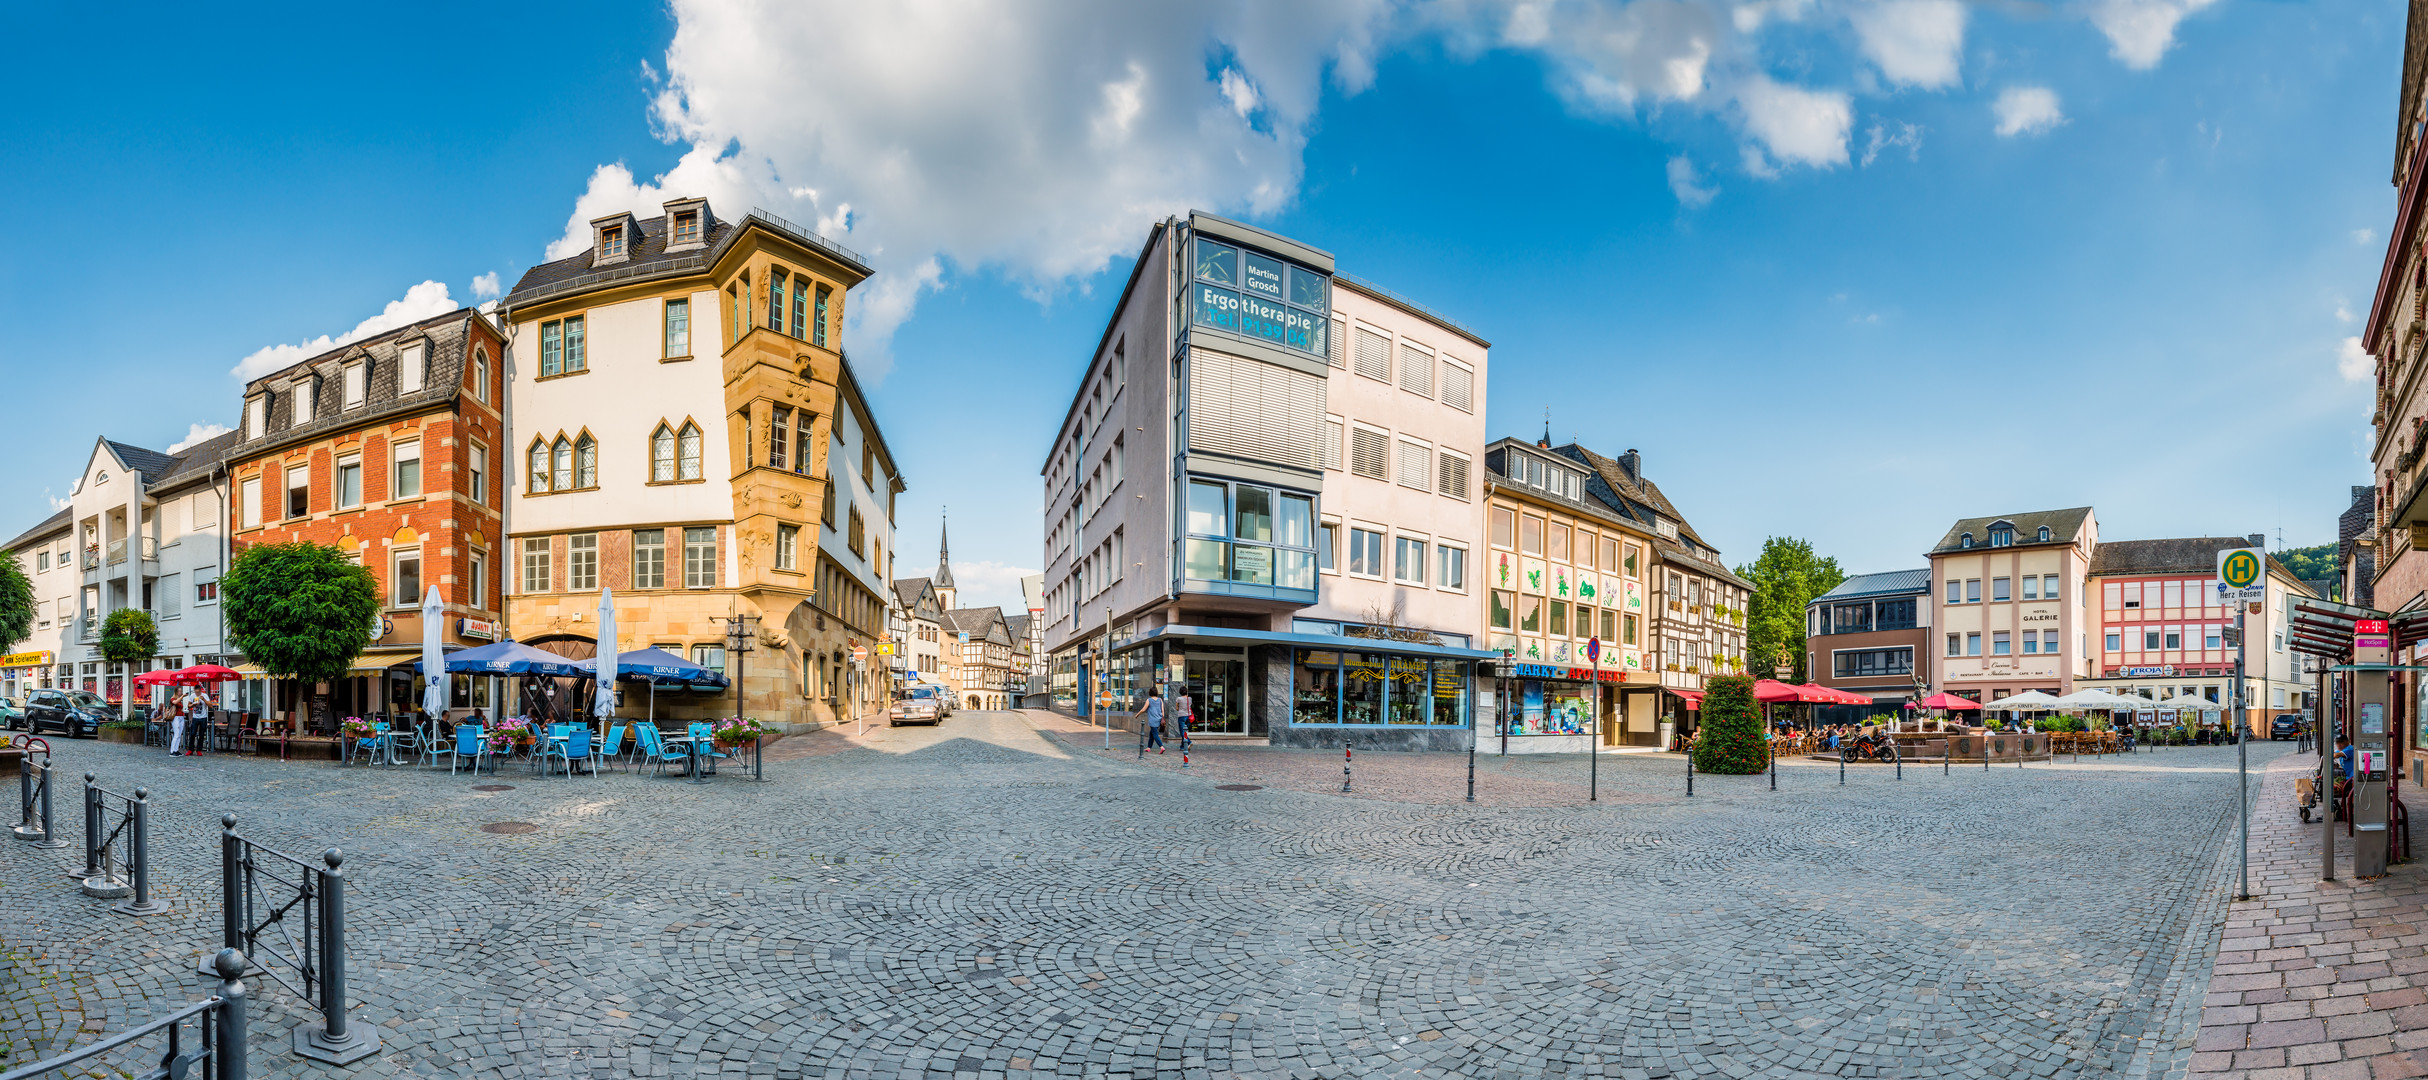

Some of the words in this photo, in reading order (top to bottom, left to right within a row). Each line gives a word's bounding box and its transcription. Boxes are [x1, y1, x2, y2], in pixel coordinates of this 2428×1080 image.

[1248, 265, 1279, 282] Martina
[1248, 277, 1279, 294] Grosch
[1208, 308, 1238, 328] Tel.
[2232, 559, 2249, 580] H
[2220, 591, 2235, 599] Herz
[2239, 590, 2261, 598] Reisen
[470, 621, 490, 633] AVANTI
[15, 653, 40, 665] Spielwaren
[486, 661, 511, 669] KIRNER
[1344, 658, 1384, 668] Blumenhaus
[653, 666, 680, 674] KIRNER
[1513, 663, 1558, 677] MARKT
[1568, 667, 1627, 682] APOTHEKE
